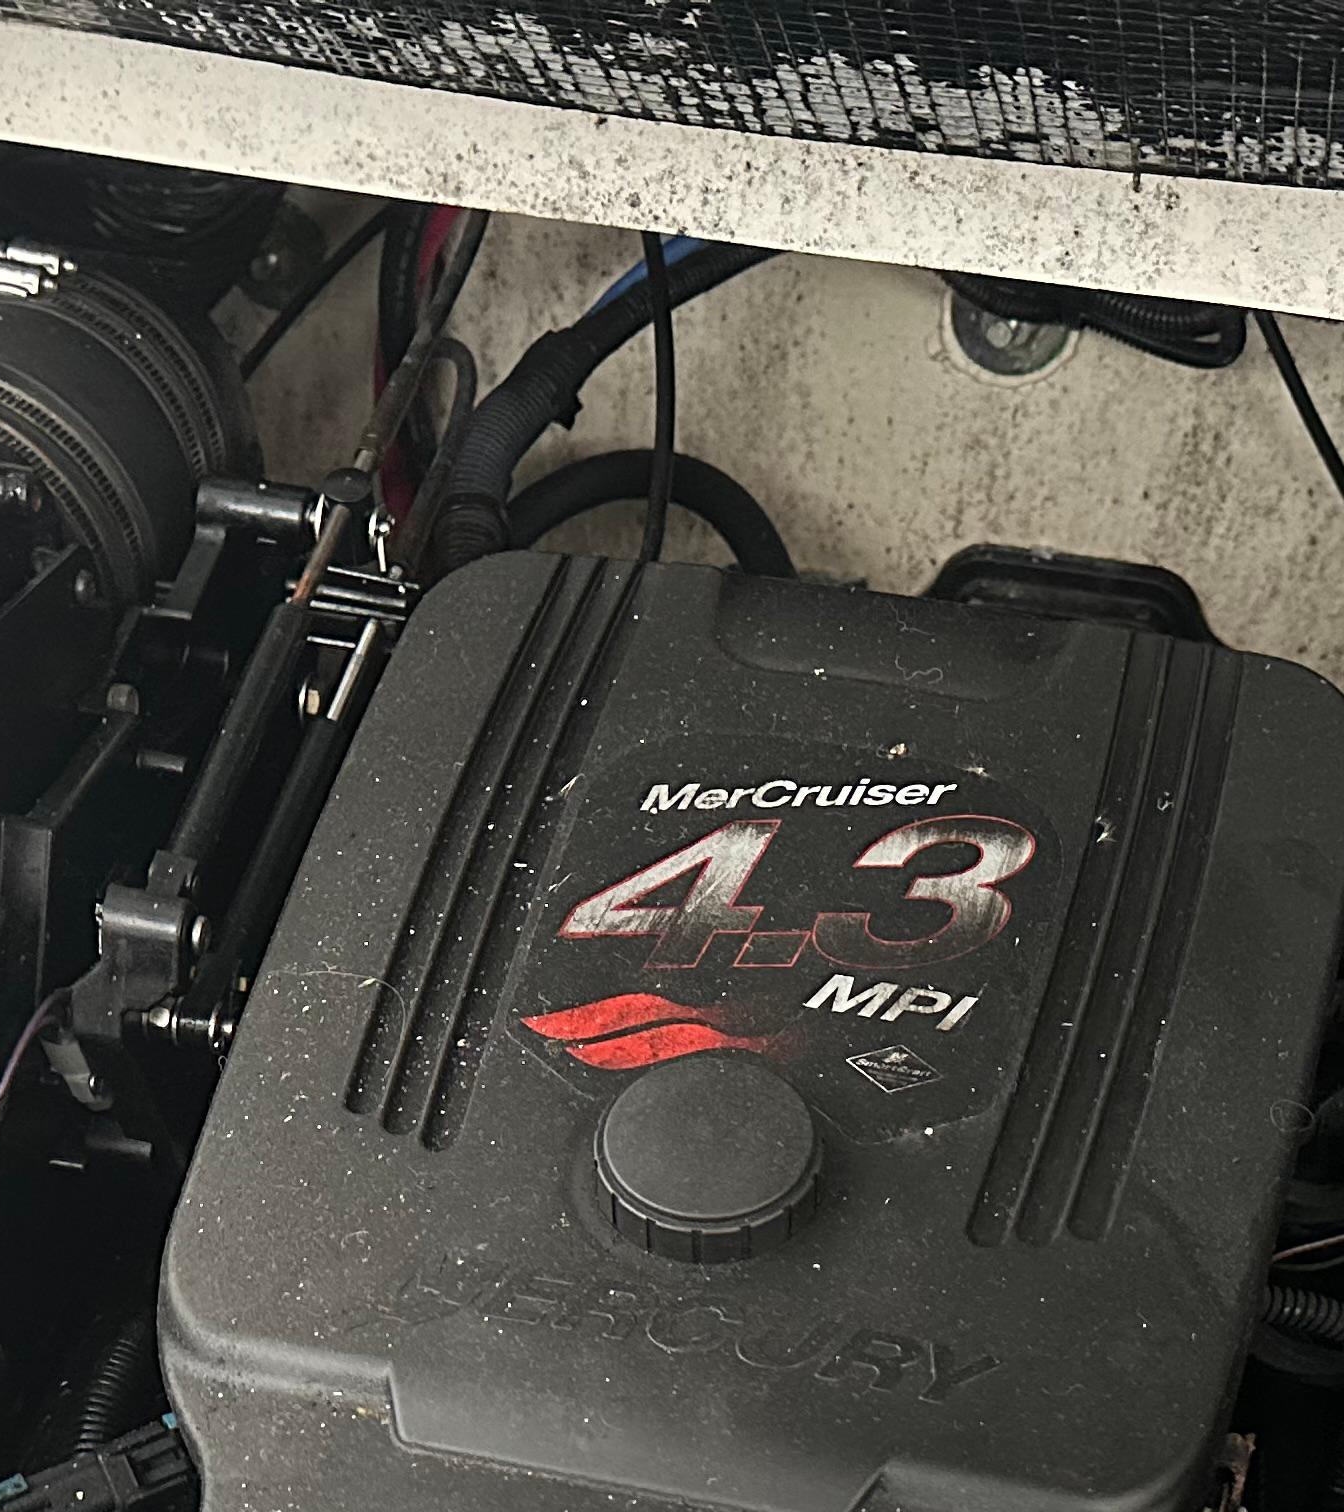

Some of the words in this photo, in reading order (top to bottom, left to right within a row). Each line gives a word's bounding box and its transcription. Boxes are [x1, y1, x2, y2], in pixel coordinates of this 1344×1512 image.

[641, 778, 958, 811] MerCruiser
[558, 814, 1037, 969] 4.3
[803, 975, 979, 1031] MPI
[350, 1258, 1003, 1404] MERCURY
